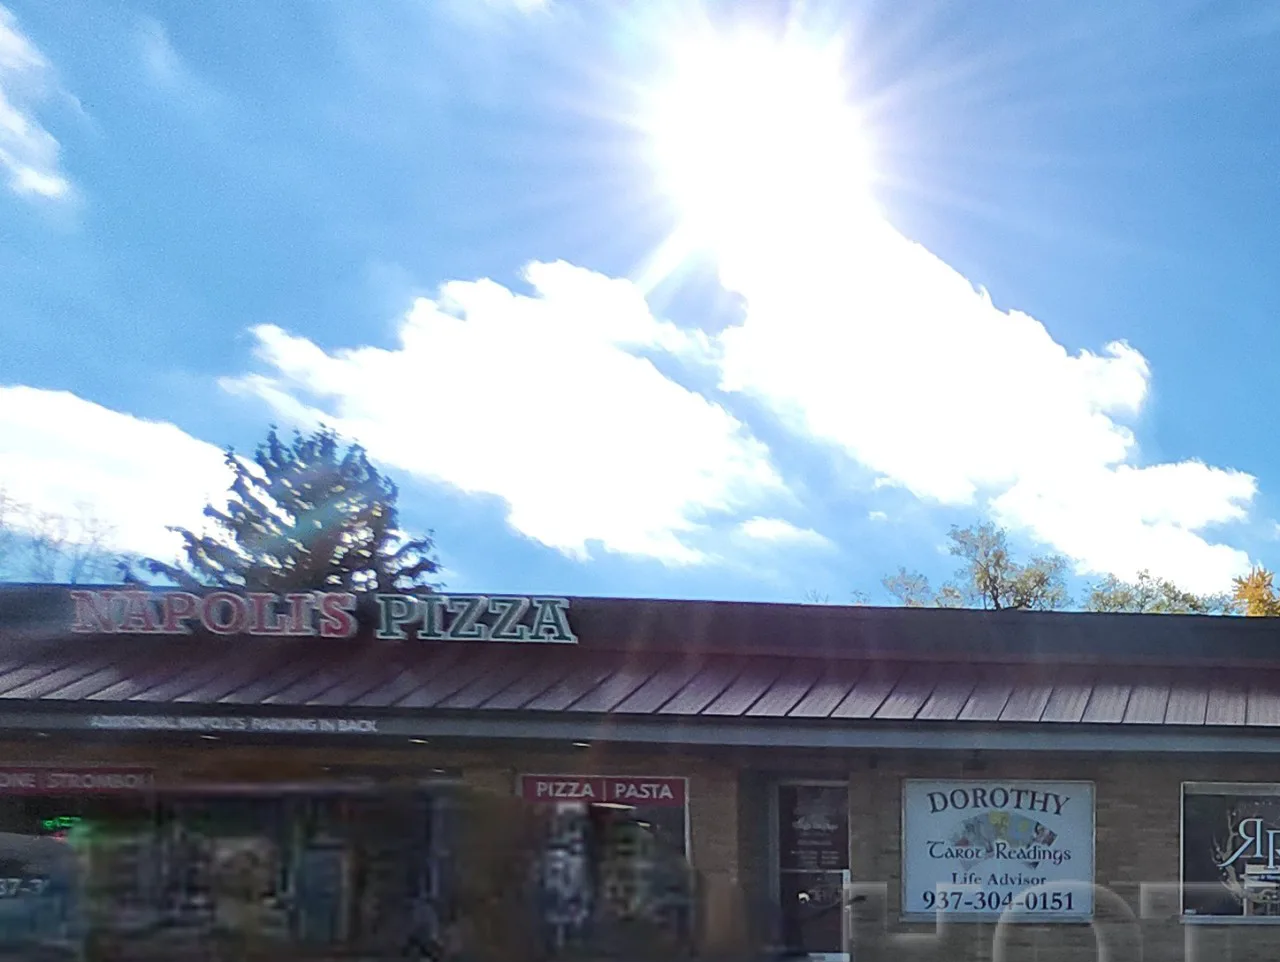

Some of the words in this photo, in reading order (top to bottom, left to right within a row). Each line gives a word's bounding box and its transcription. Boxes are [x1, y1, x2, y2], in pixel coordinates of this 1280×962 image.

[375, 593, 580, 645] PIZZA
[338, 719, 379, 732] BACK
[536, 782, 595, 798] PIZZA
[615, 783, 674, 799] PASTA
[926, 787, 1071, 816] DOROTHY
[995, 842, 1072, 865] Readings
[951, 872, 982, 886] Life
[987, 872, 1047, 887] Advisor
[922, 890, 1075, 911] 937-304-0151
